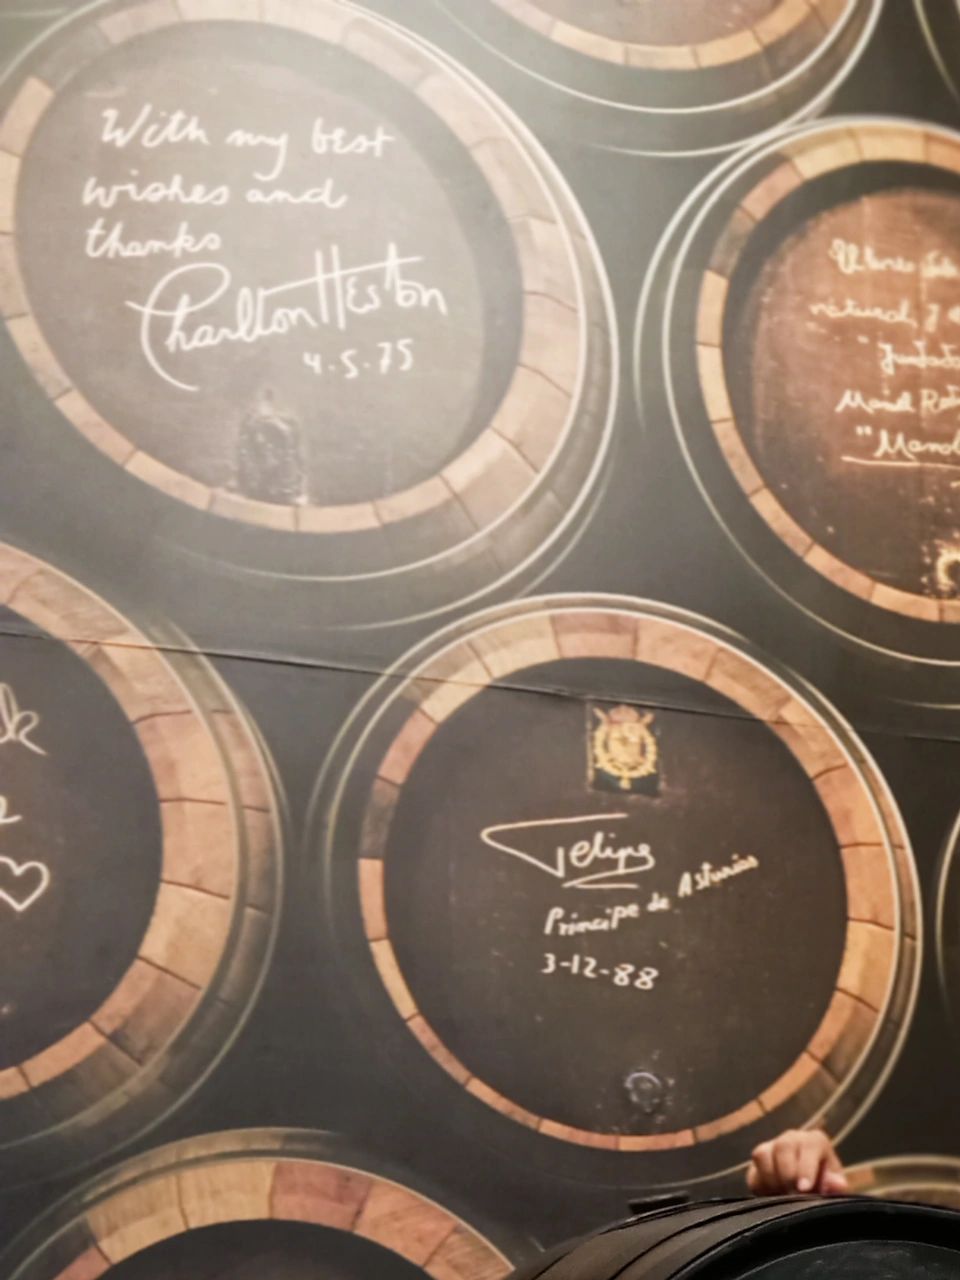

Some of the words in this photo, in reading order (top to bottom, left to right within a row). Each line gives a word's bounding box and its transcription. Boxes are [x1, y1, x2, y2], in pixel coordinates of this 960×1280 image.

[101, 104, 210, 148] With
[225, 128, 289, 181] my
[311, 116, 395, 157] best
[82, 169, 230, 209] wishes
[245, 177, 348, 209] and
[85, 217, 222, 258] thanks
[646, 892, 669, 912] de
[540, 952, 660, 990] 3-12-88
